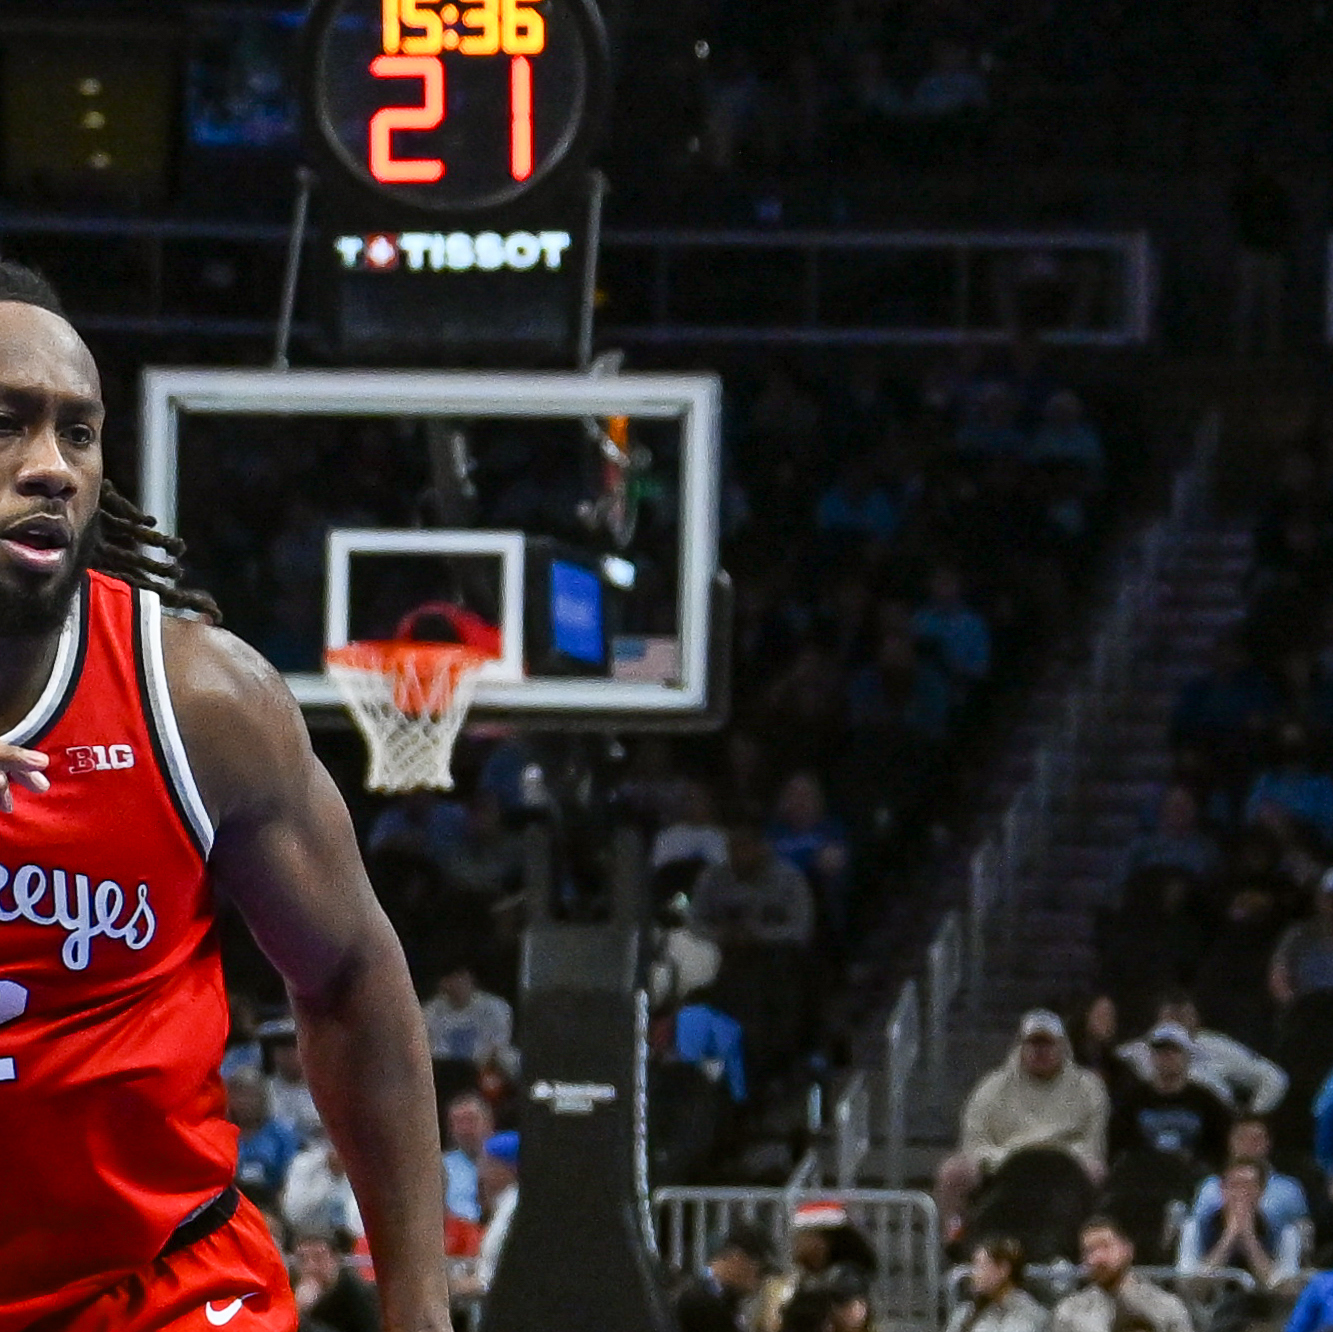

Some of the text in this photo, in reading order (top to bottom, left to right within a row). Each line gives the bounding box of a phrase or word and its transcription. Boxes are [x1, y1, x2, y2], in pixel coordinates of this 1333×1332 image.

[381, 0, 545, 55] 15:36
[369, 55, 533, 183] 21
[400, 231, 571, 270] TISSOT
[0, 864, 156, 970] eyes
